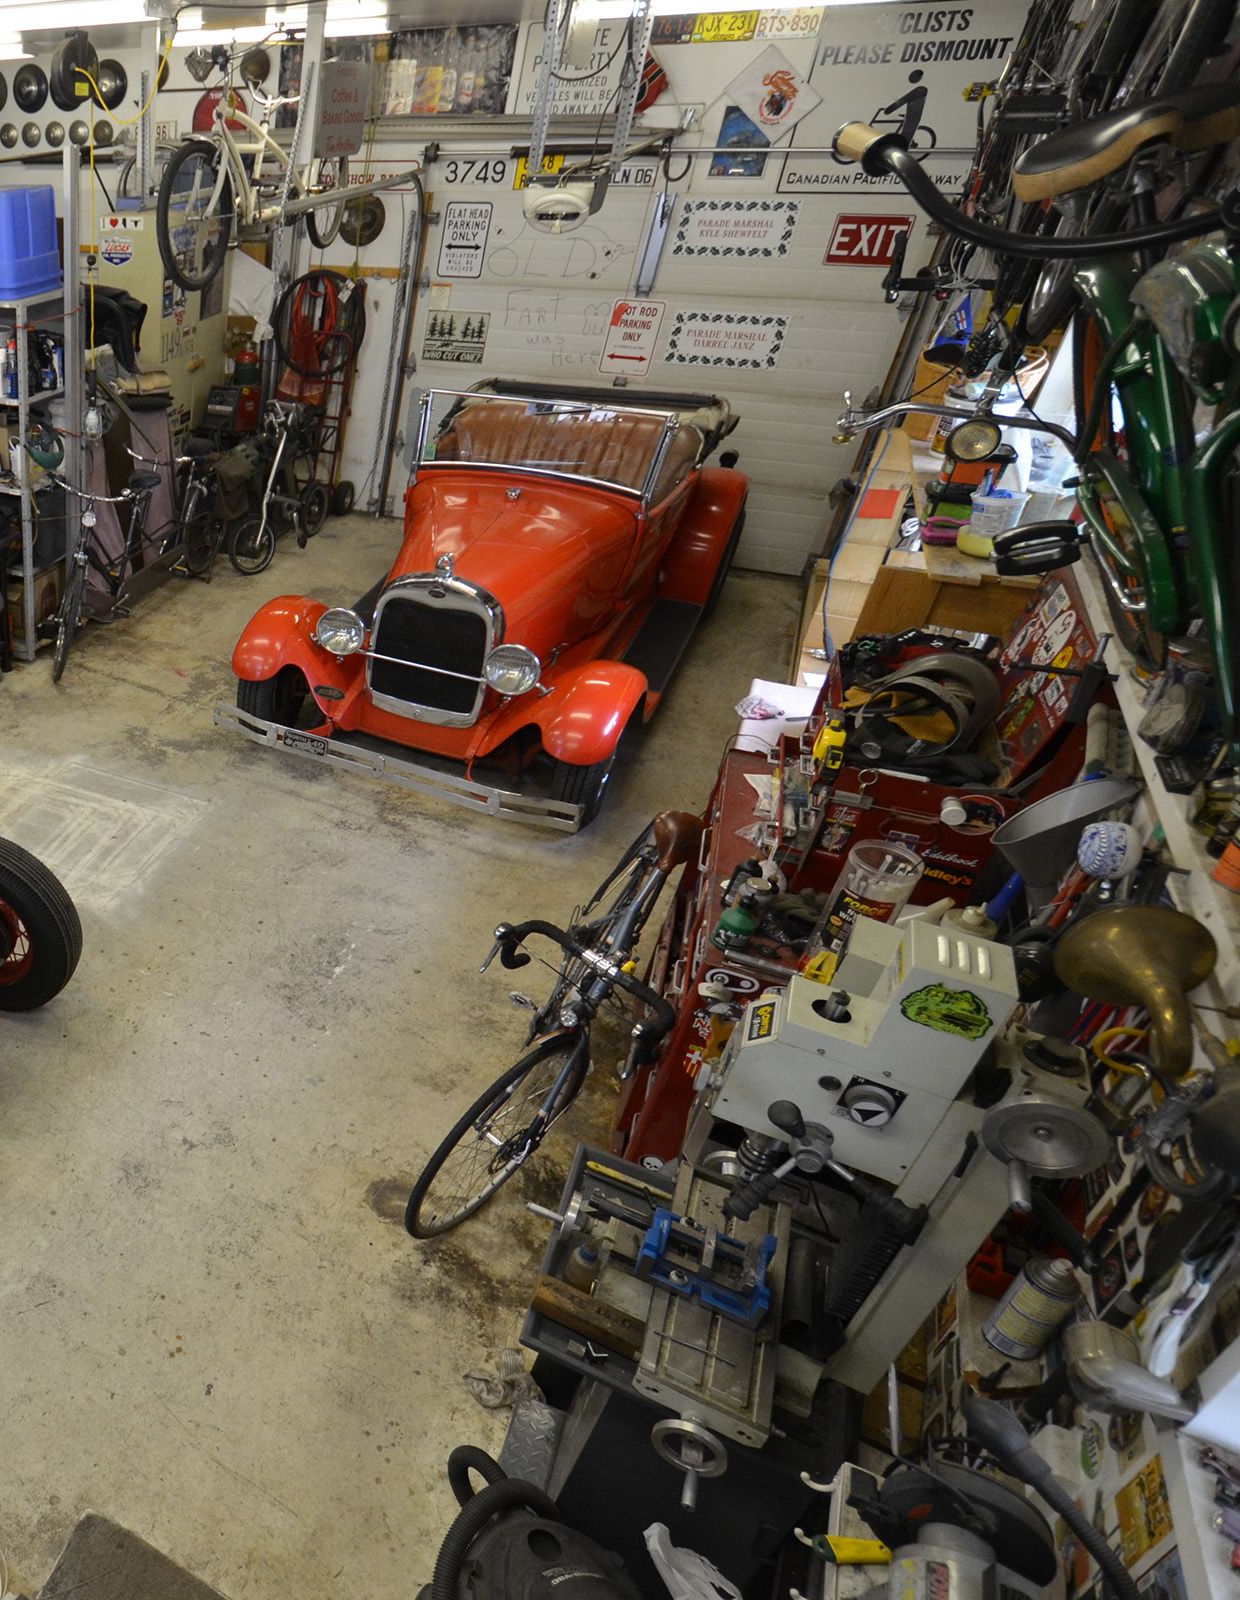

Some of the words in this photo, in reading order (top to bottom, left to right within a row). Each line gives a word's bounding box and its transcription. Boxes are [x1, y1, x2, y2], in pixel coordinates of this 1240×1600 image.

[820, 43, 895, 66] PLEASE
[899, 37, 1014, 64] DISMOUNT
[573, 90, 594, 101] WILL
[599, 89, 611, 101] BE
[561, 103, 590, 114] AWAY
[591, 102, 603, 113] AT
[448, 208, 468, 219] FLAT
[468, 208, 490, 219] HEAD
[447, 220, 487, 231] PARKING
[697, 219, 730, 228] PARADE
[733, 219, 775, 229] MARSHAL
[451, 231, 479, 241] ONLY
[698, 229, 721, 238] KYLE
[722, 229, 769, 239] SHEWFELT
[828, 224, 909, 258] EXIT
[504, 288, 566, 326] FART
[639, 306, 658, 317] ROD
[619, 319, 652, 330] PARKING
[622, 331, 642, 342] ONLY
[686, 329, 720, 339] PARADE
[723, 331, 768, 342] MARSHAL
[693, 339, 729, 350] DARREL
[423, 350, 443, 360] WHO
[442, 351, 460, 361] CUT
